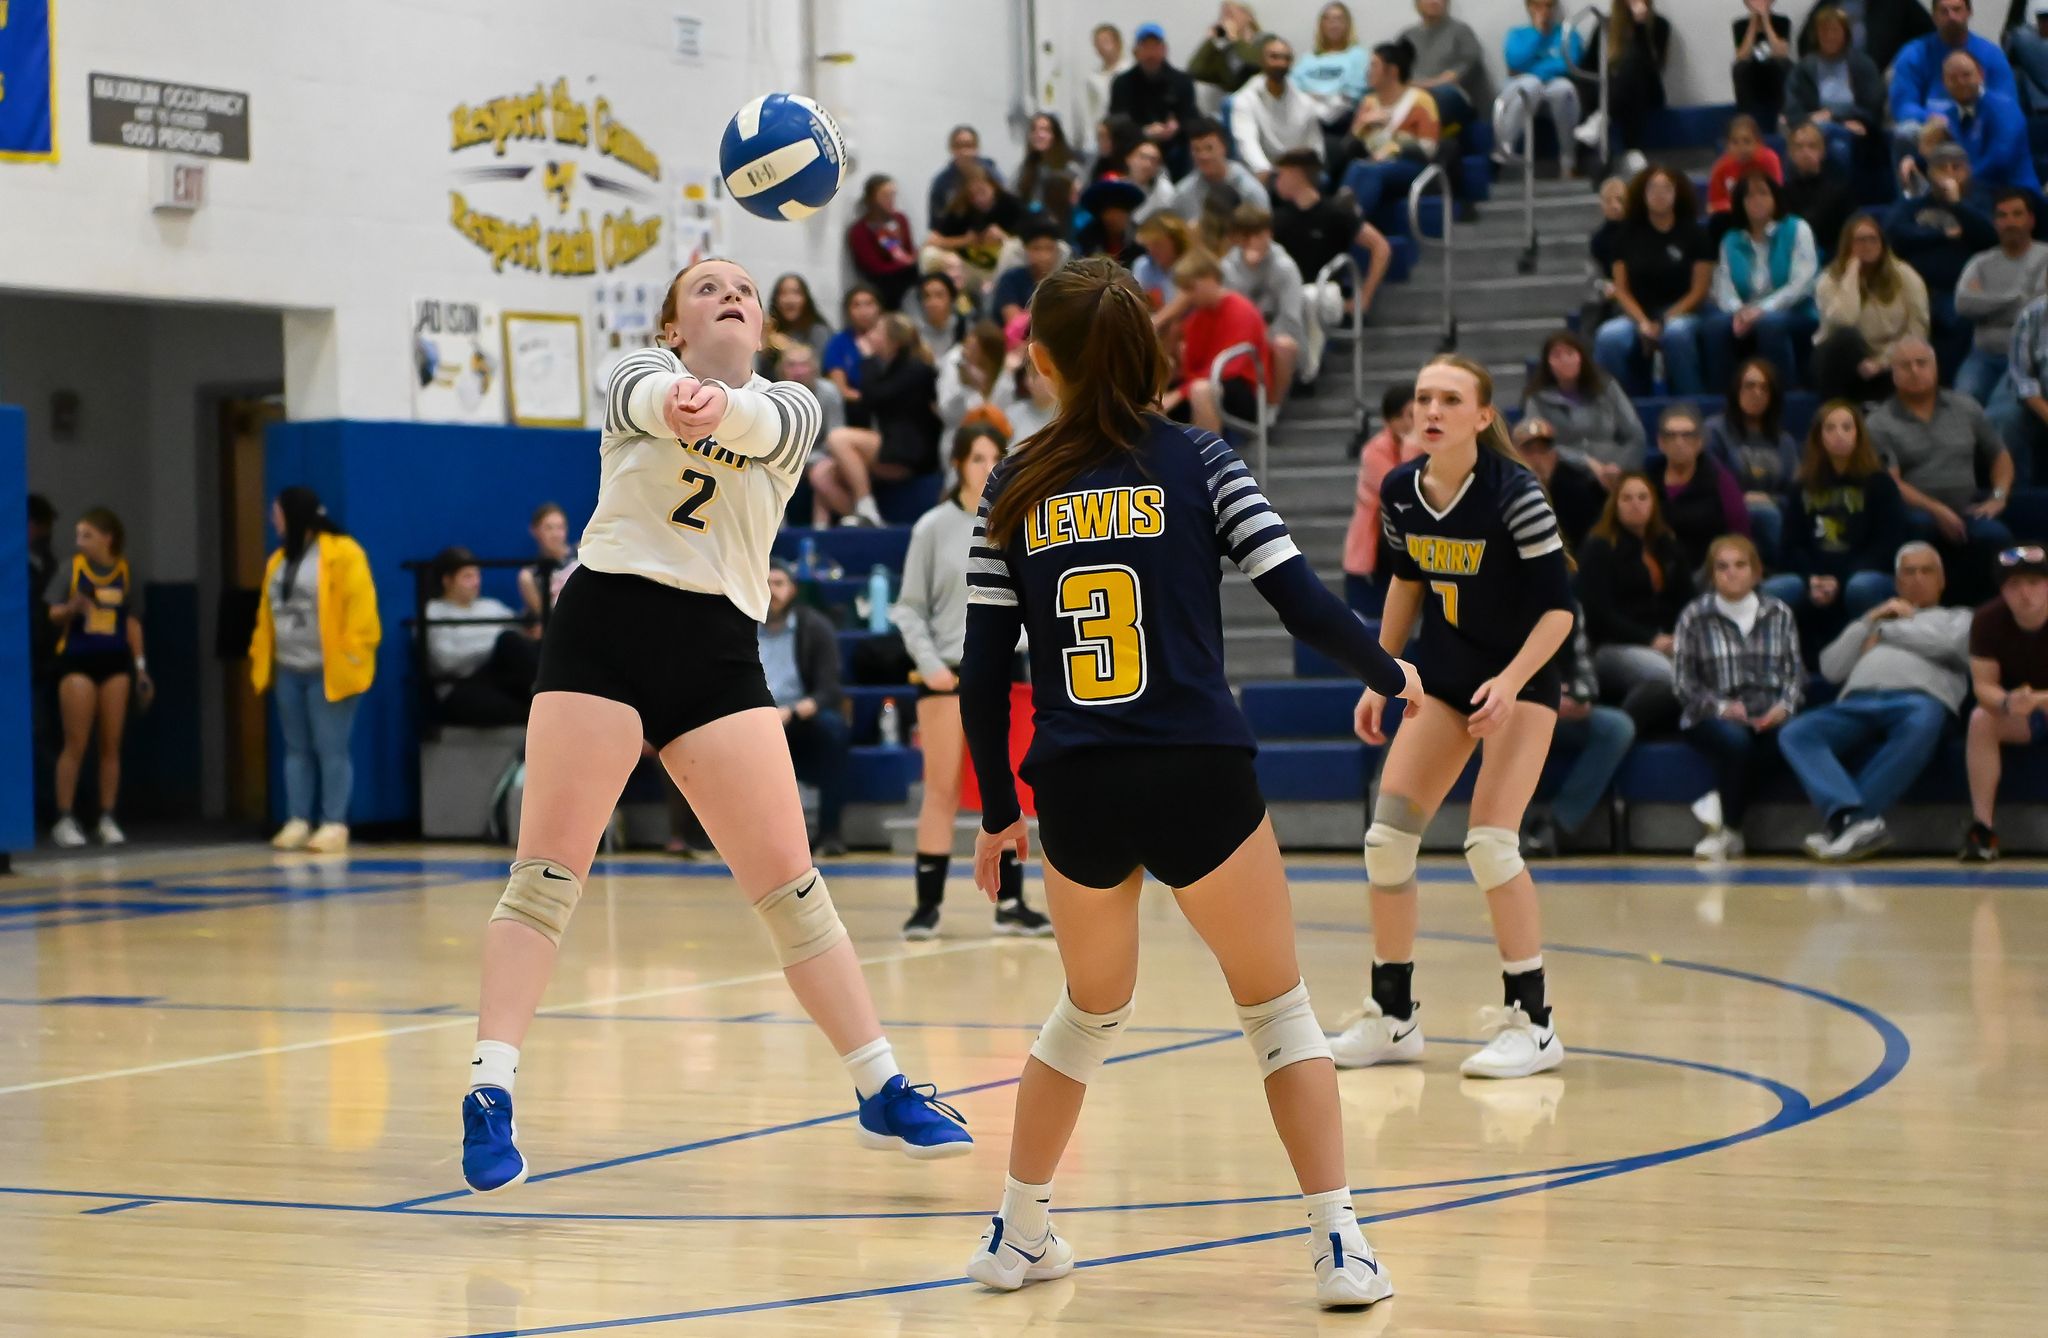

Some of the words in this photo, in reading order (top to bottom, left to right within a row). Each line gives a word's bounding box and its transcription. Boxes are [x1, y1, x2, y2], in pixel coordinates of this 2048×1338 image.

[93, 77, 161, 104] MAXIMUM
[163, 85, 244, 116] OCCUPANCY
[449, 83, 546, 157] Respect
[552, 76, 588, 148] the
[158, 126, 223, 155] PERSONS
[448, 190, 542, 273] Respect
[667, 466, 719, 533] 2
[1025, 485, 1164, 556] LEWIS
[1405, 533, 1486, 575] PERRY
[1056, 564, 1147, 705] 3
[1430, 580, 1459, 628] 7
